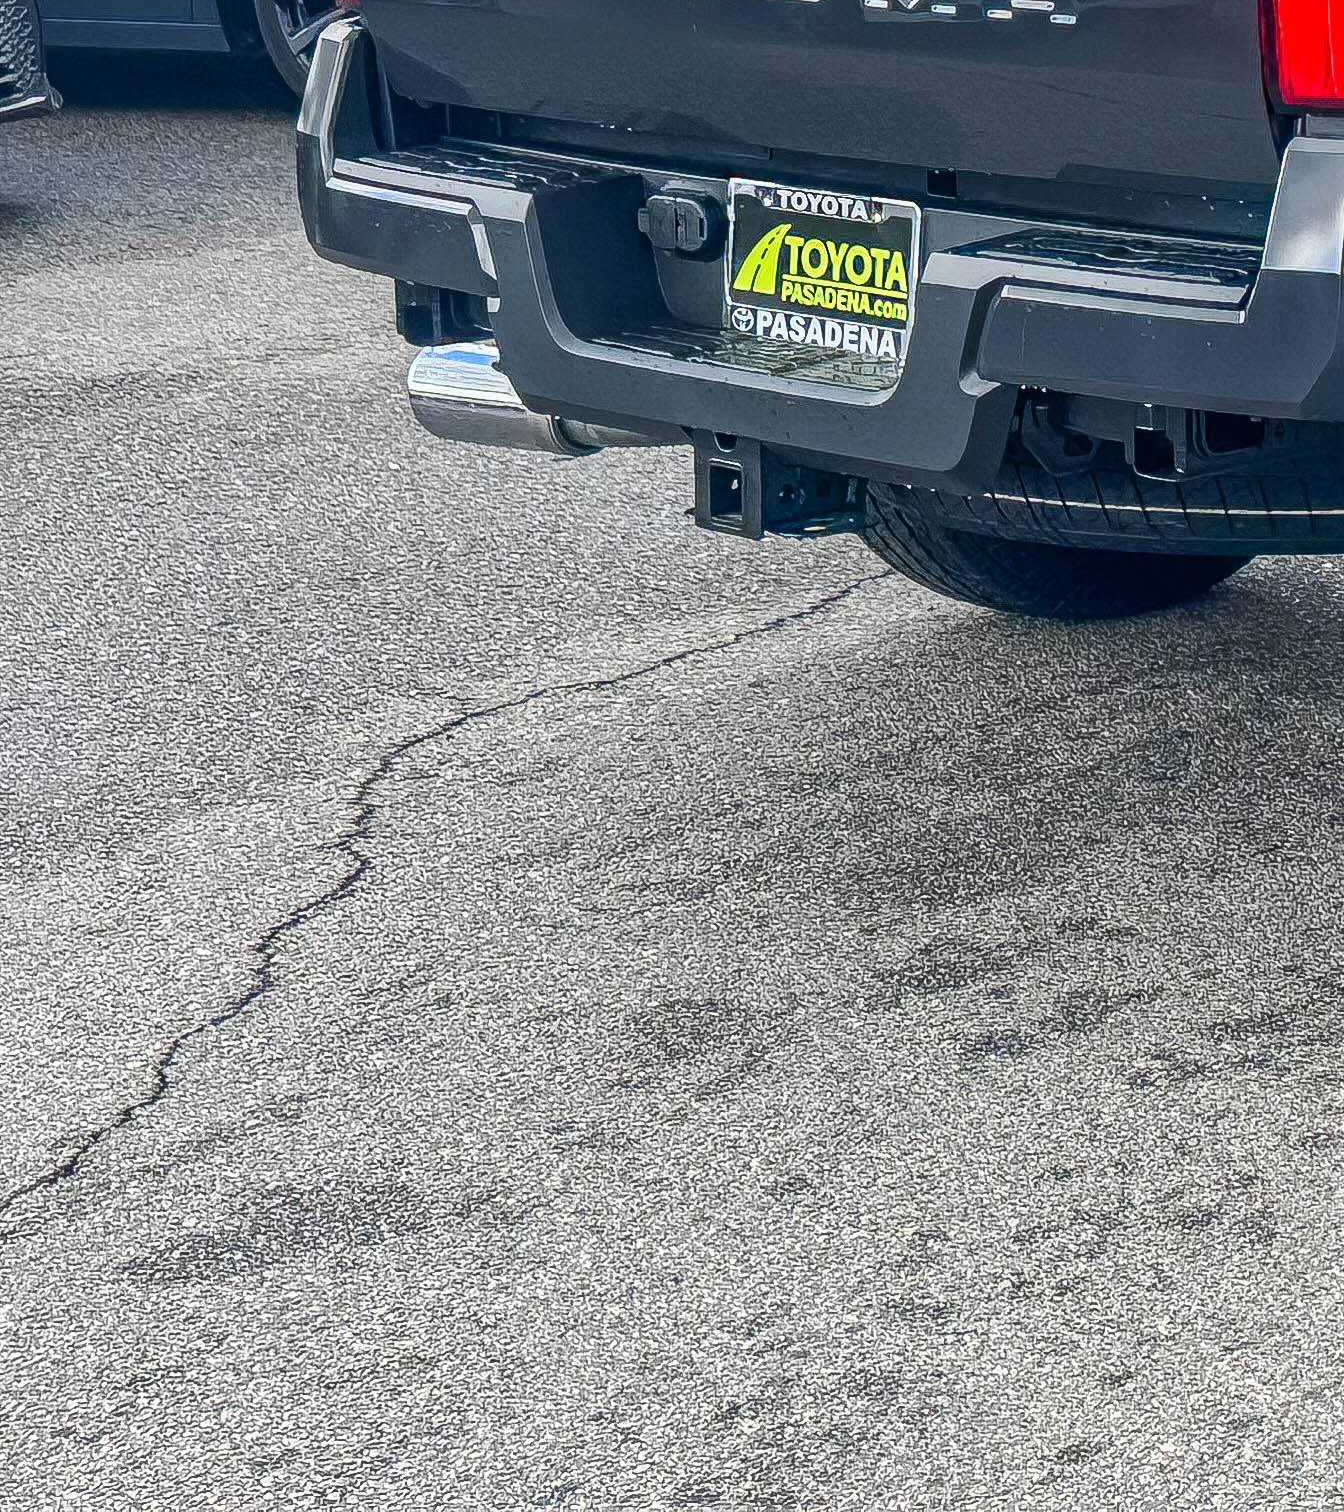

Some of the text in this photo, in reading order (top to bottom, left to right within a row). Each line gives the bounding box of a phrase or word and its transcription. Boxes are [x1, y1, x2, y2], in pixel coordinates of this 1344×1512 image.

[776, 188, 869, 221] TOYOTA
[783, 235, 908, 293] TOYOTA
[780, 280, 908, 322] PASADENA.com
[756, 309, 897, 358] PASADENA
